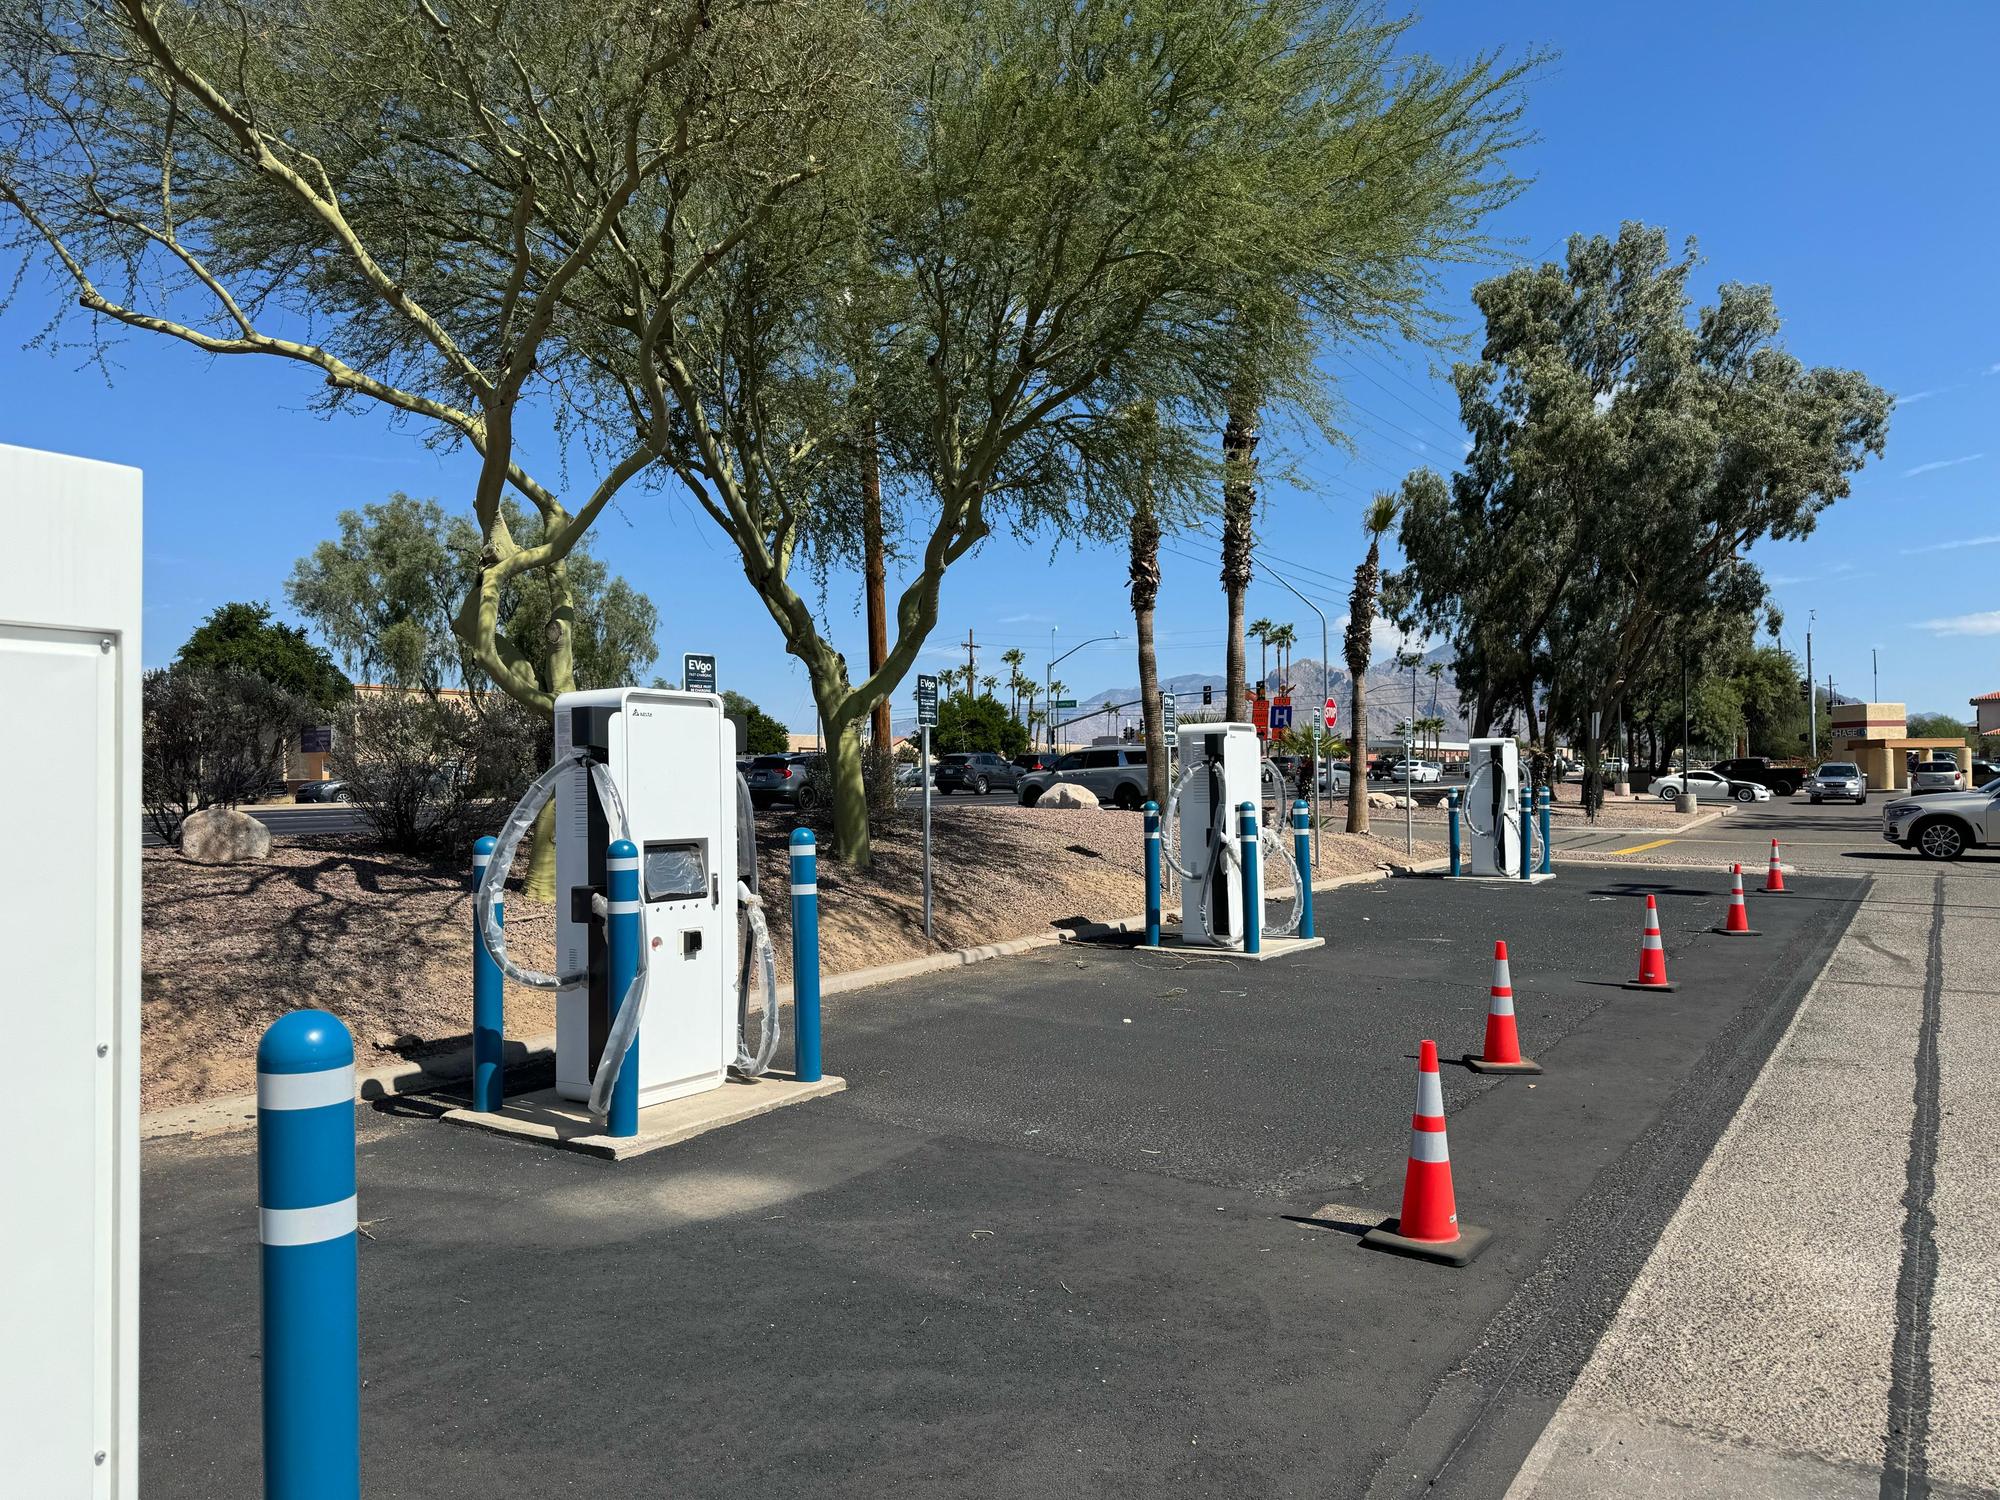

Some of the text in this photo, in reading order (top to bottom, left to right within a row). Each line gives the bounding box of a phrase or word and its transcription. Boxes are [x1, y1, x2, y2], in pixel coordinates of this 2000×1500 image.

[688, 660, 712, 673] EVgo
[920, 678, 935, 690] EVgo
[1275, 709, 1288, 725] H
[1325, 707, 1337, 718] STOP
[1831, 729, 1858, 737] CHASE
